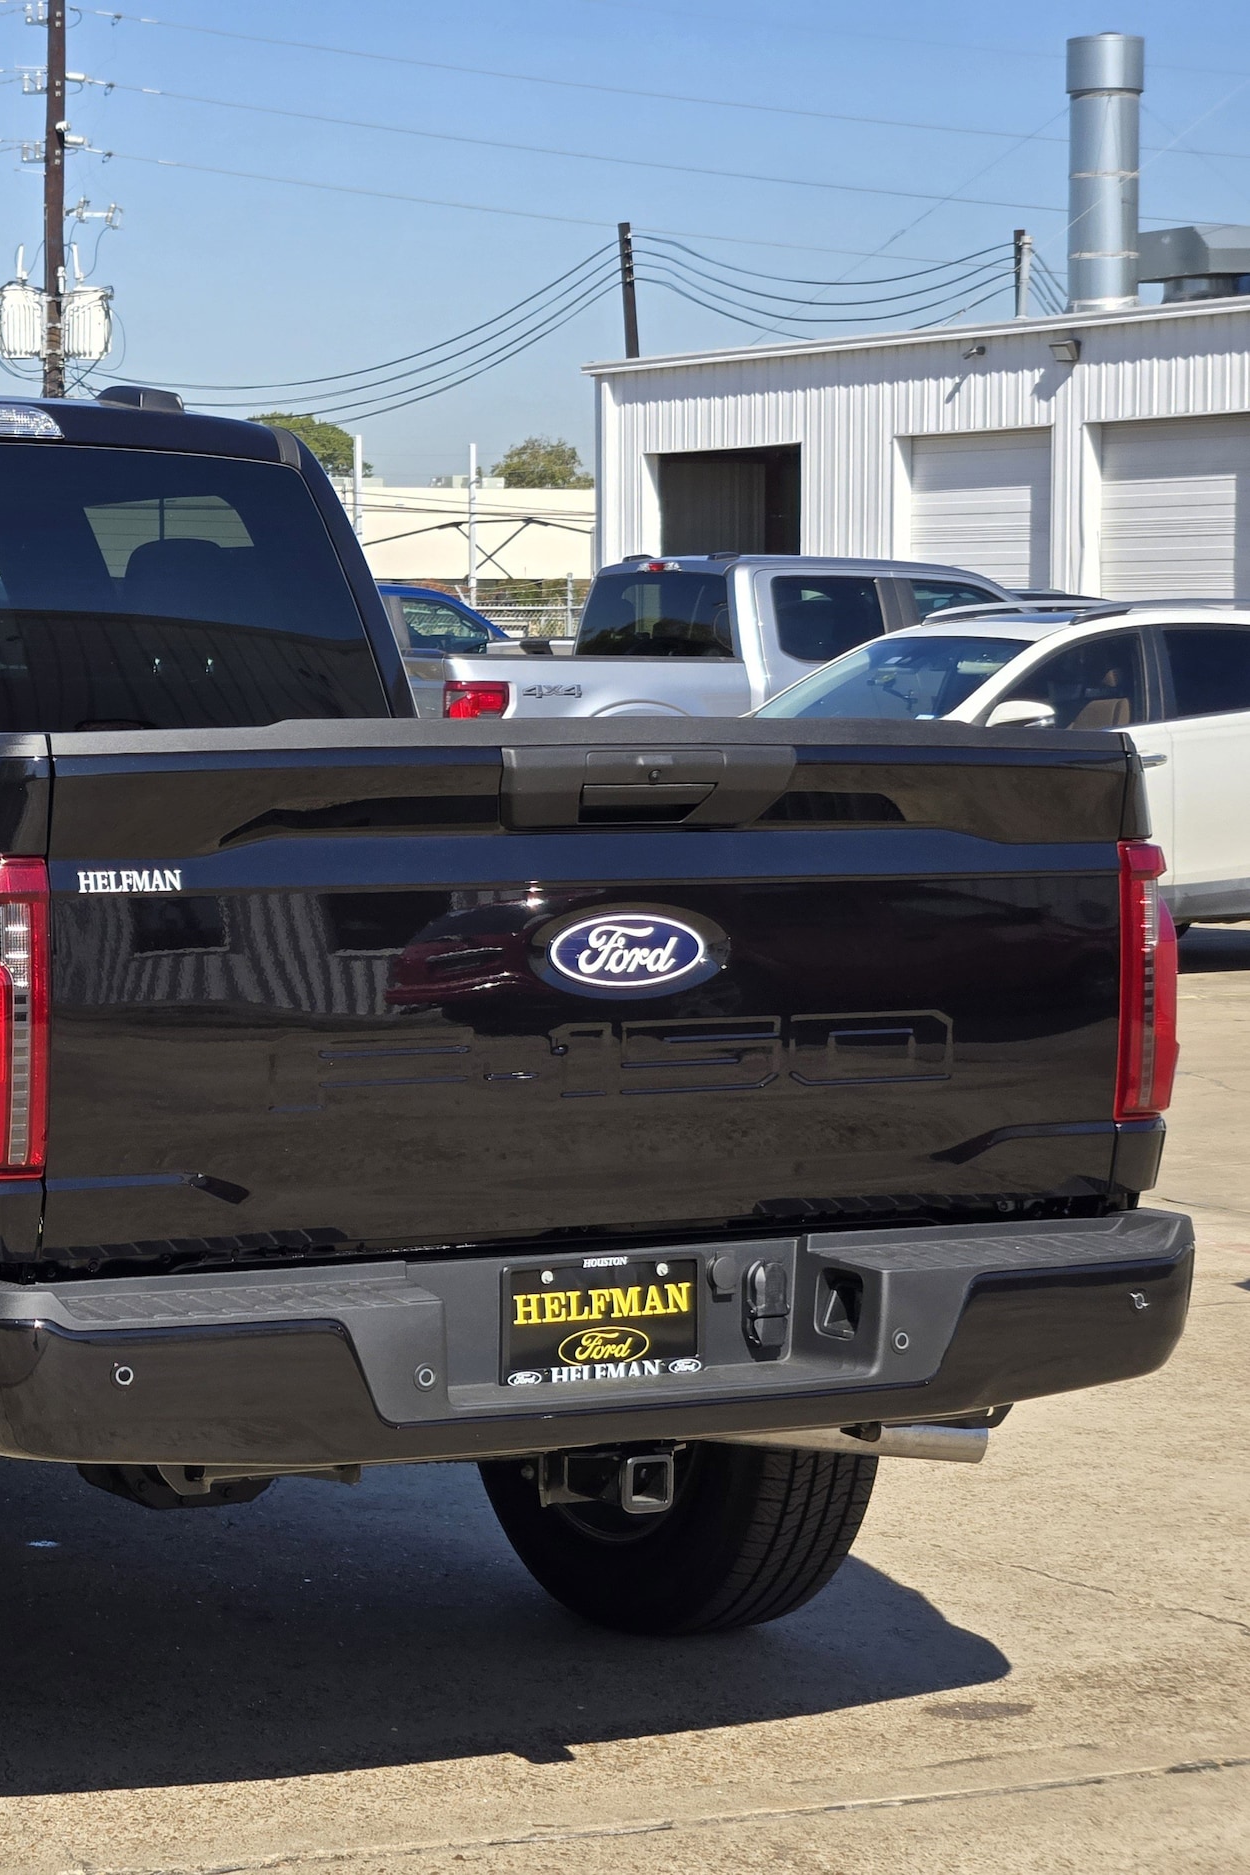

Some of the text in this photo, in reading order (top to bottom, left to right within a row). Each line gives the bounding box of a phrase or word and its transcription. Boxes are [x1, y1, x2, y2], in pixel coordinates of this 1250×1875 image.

[77, 869, 182, 893] HELFMAN
[577, 925, 678, 974] Ford
[582, 1256, 628, 1269] HOUSTON
[513, 1282, 691, 1325] HELFMAN
[574, 1332, 633, 1361] Ford
